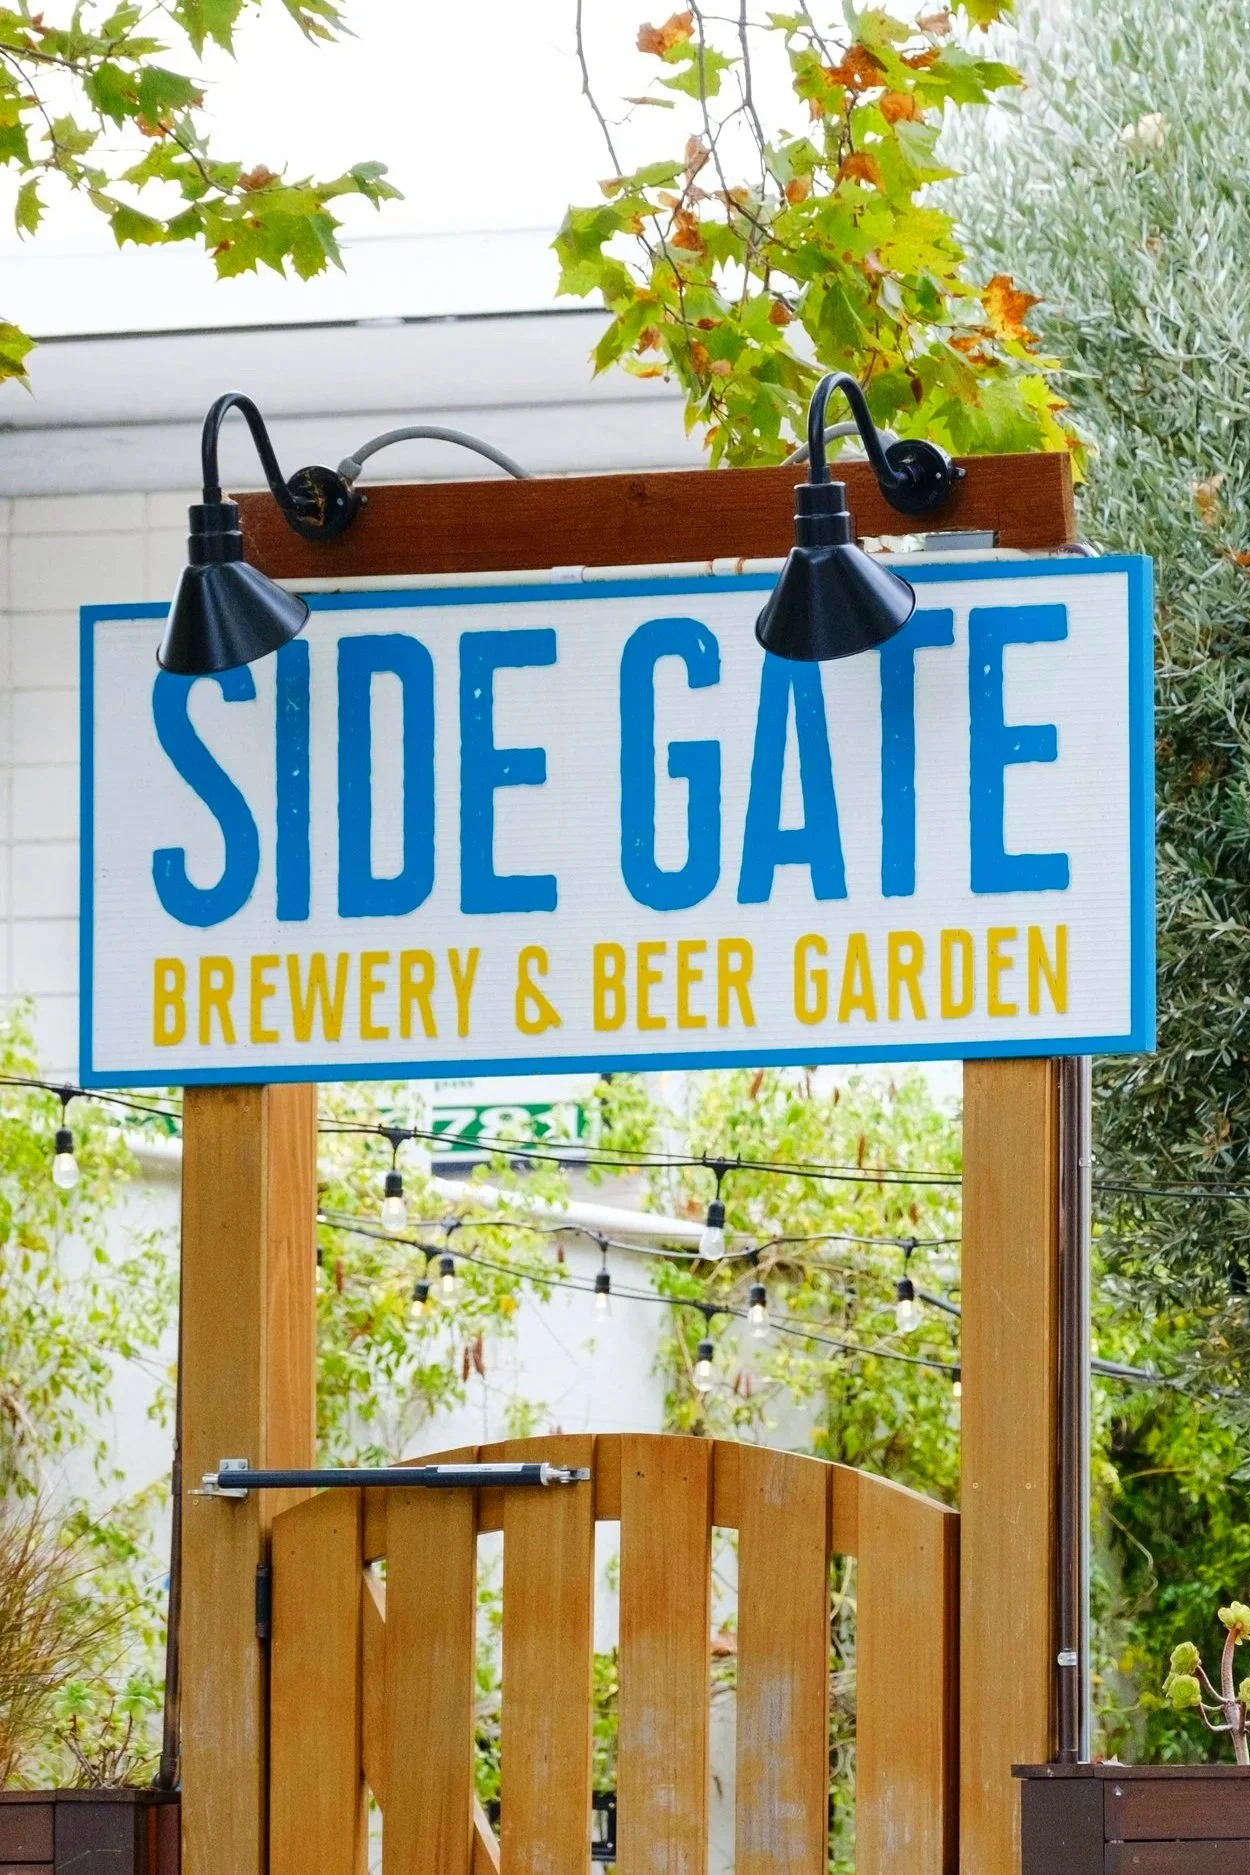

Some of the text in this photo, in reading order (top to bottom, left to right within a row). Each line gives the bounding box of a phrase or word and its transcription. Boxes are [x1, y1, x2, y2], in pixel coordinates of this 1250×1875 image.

[151, 603, 1071, 929] SIDE GATE
[153, 923, 1069, 1047] BREWERY & BEER GARDEN
